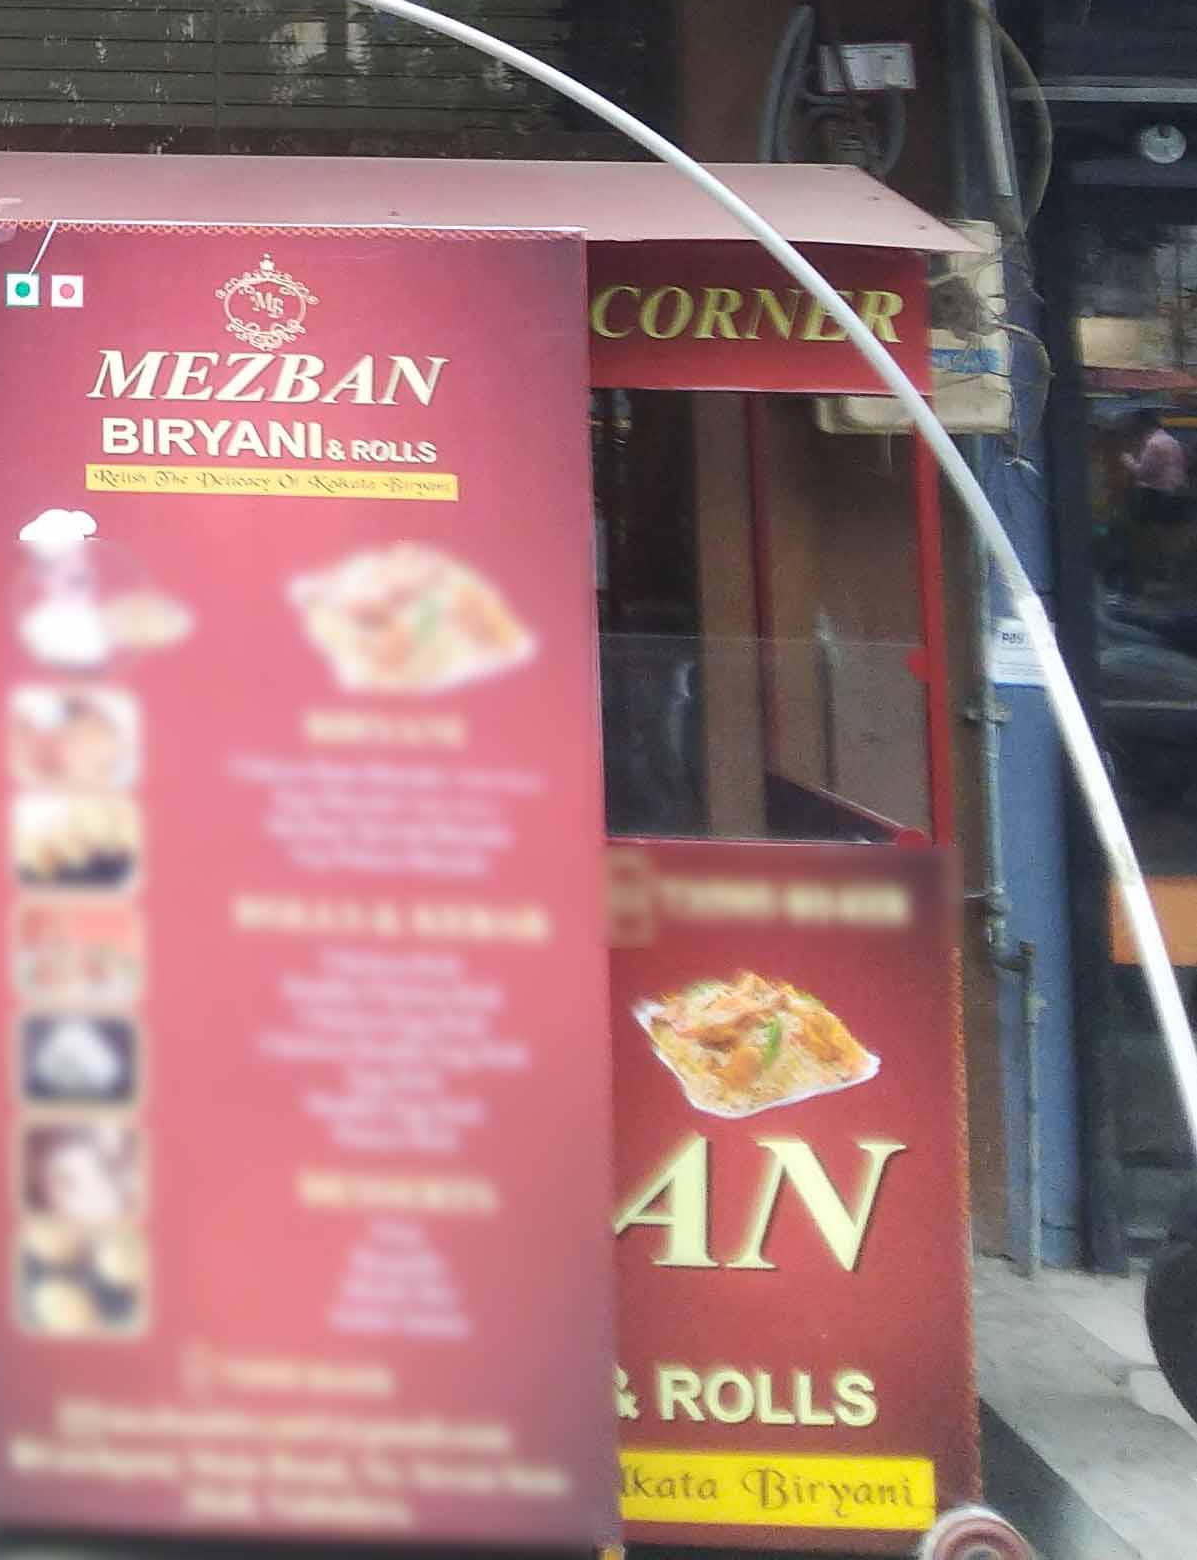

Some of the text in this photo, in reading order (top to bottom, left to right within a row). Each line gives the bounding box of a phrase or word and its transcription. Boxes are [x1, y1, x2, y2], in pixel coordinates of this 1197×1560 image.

[86, 350, 449, 406] MEZBAN
[102, 417, 437, 464] BIRYANI & ROLLS
[657, 1367, 879, 1427] ROLLS
[739, 1466, 915, 1518] Biryani
